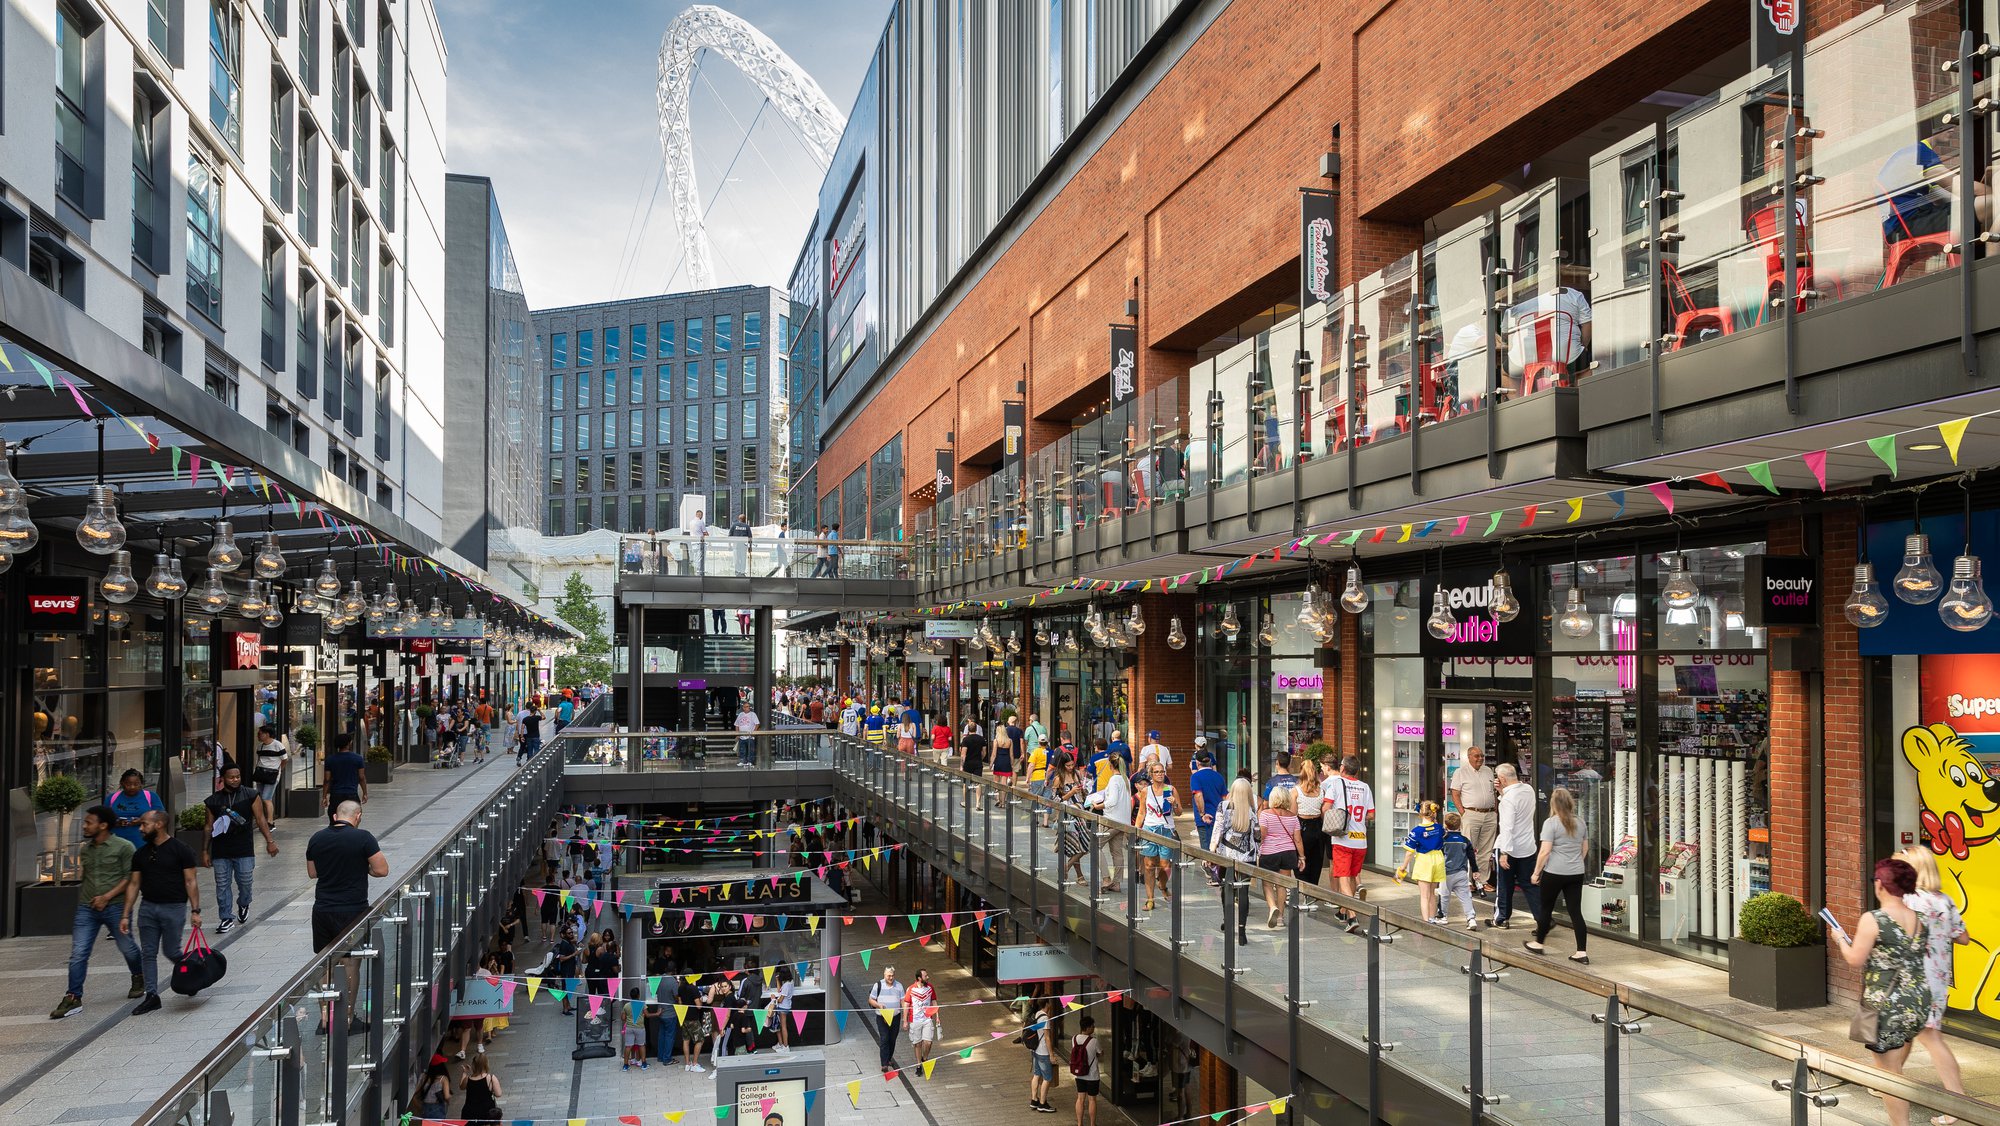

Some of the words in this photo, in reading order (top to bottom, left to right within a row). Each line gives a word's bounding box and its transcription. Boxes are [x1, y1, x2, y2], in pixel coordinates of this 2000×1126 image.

[1119, 349, 1133, 393] Zizzi
[1767, 576, 1812, 593] beauty
[1772, 592, 1809, 606] outlet
[1050, 631, 1060, 646] Lee
[1060, 694, 1071, 702] ee
[846, 715, 856, 723] 10
[1397, 725, 1424, 735] beau
[744, 884, 802, 900] EATS
